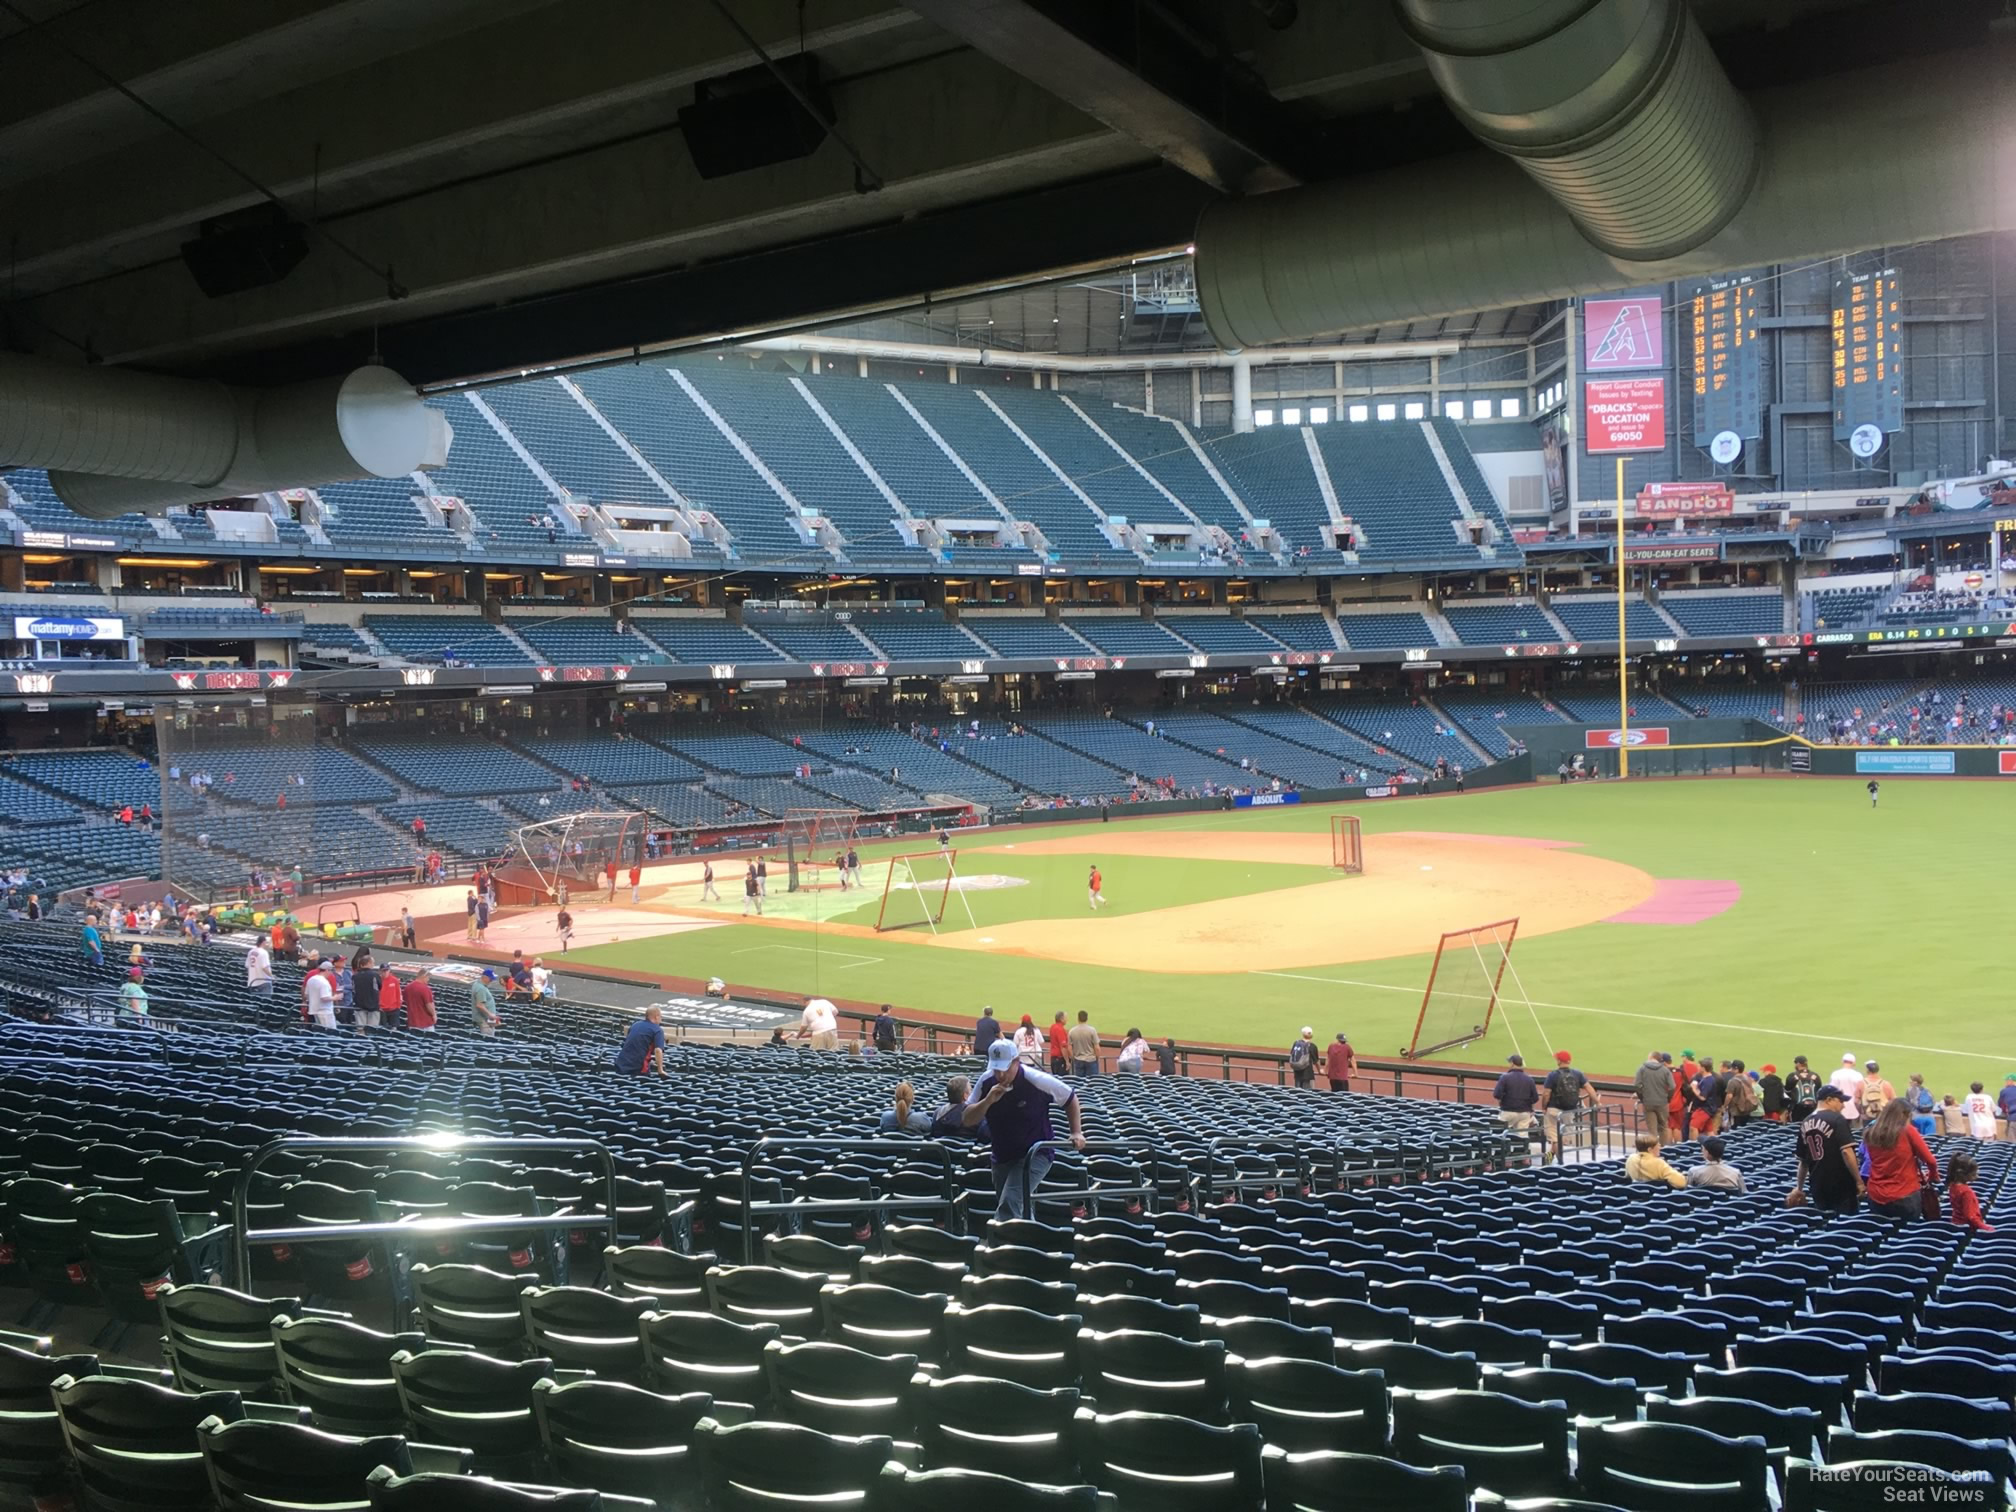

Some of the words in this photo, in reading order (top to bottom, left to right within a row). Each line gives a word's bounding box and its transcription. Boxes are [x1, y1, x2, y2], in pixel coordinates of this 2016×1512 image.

[1852, 274, 1869, 283] TEAM
[1712, 281, 1728, 290] TEAM
[1876, 280, 1882, 289] 2
[1890, 281, 1895, 290] F
[1876, 288, 1882, 298] 2
[1749, 330, 1756, 339] 3
[1591, 383, 1612, 391] Report
[1614, 382, 1633, 390] Guest
[1620, 391, 1629, 399] by
[1631, 389, 1653, 398] Texting
[1601, 413, 1650, 425] LOCATION
[1610, 431, 1643, 442] 69050
[1641, 496, 1730, 510] SANDLOT
[1690, 548, 1714, 557] SEATS
[1816, 633, 1854, 643] CARRASCO
[1868, 632, 1883, 640] ERA
[1887, 631, 1905, 639] 6.14
[1908, 630, 1919, 638] PC
[1925, 629, 1932, 637] 0
[1938, 628, 1944, 636] B
[1952, 627, 1959, 635] 0
[1967, 626, 1974, 635] S
[1982, 625, 1989, 634] 0
[1024, 1035, 1034, 1047] 12
[1972, 1103, 1985, 1113] 22
[1807, 1134, 1825, 1160] 13
